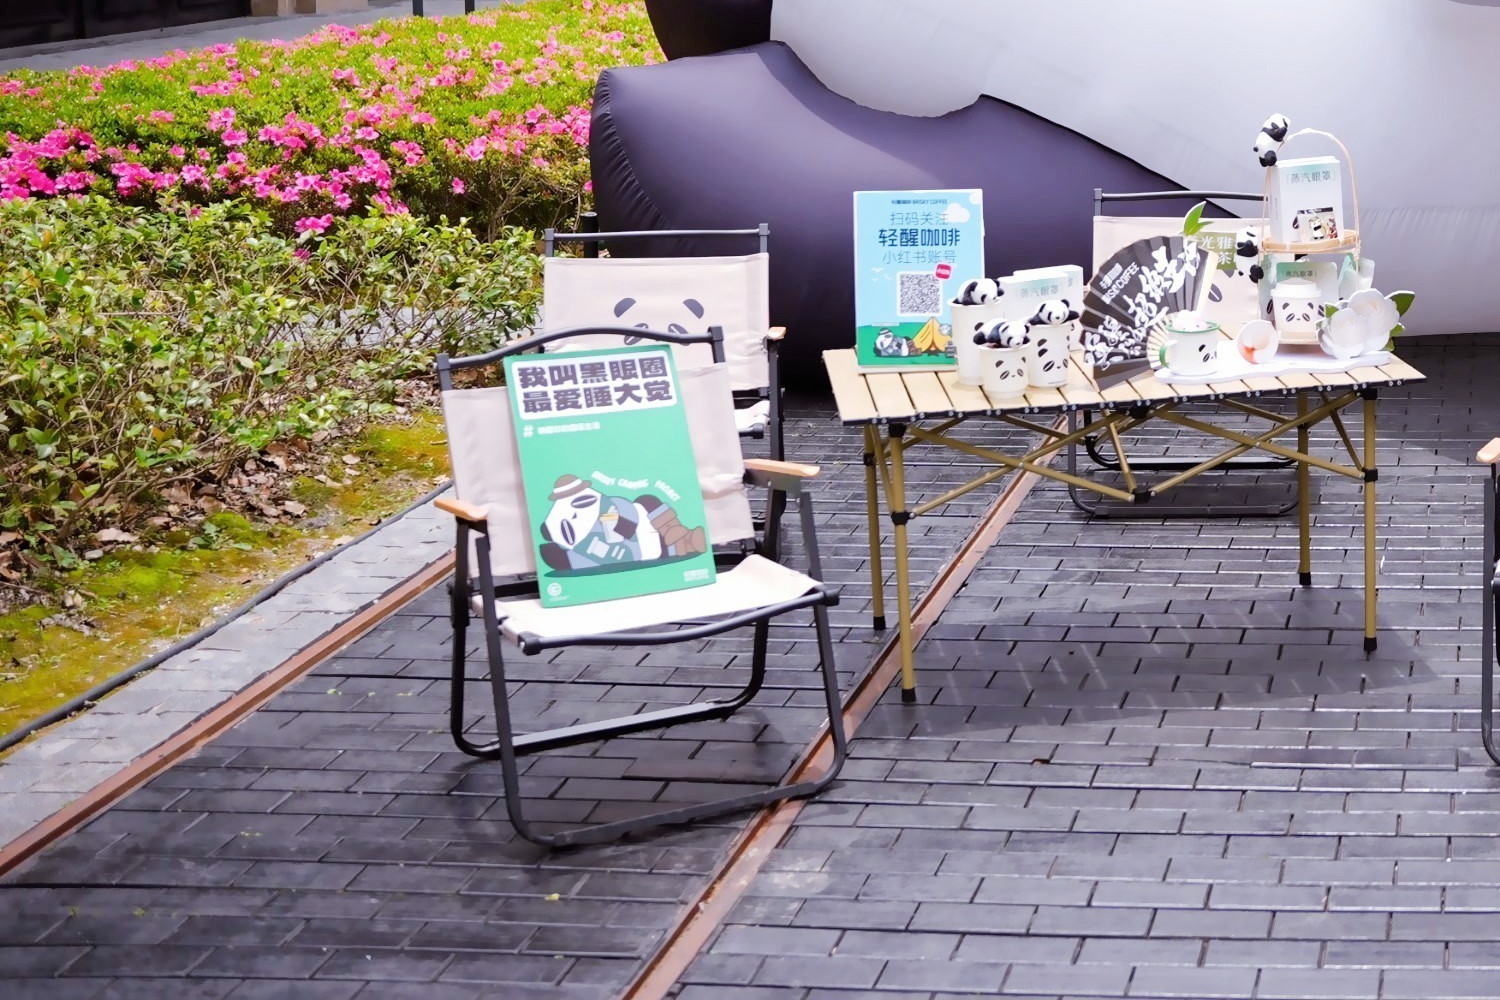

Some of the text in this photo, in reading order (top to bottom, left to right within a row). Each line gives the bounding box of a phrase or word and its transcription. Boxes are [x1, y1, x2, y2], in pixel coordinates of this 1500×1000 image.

[890, 211, 950, 226] 扫码关注
[878, 228, 961, 247] 轻醒咖啡
[882, 250, 957, 264] 小红书账号
[517, 356, 668, 389] 我叫黑眼圈
[522, 379, 673, 413] 最爱睡大觉
